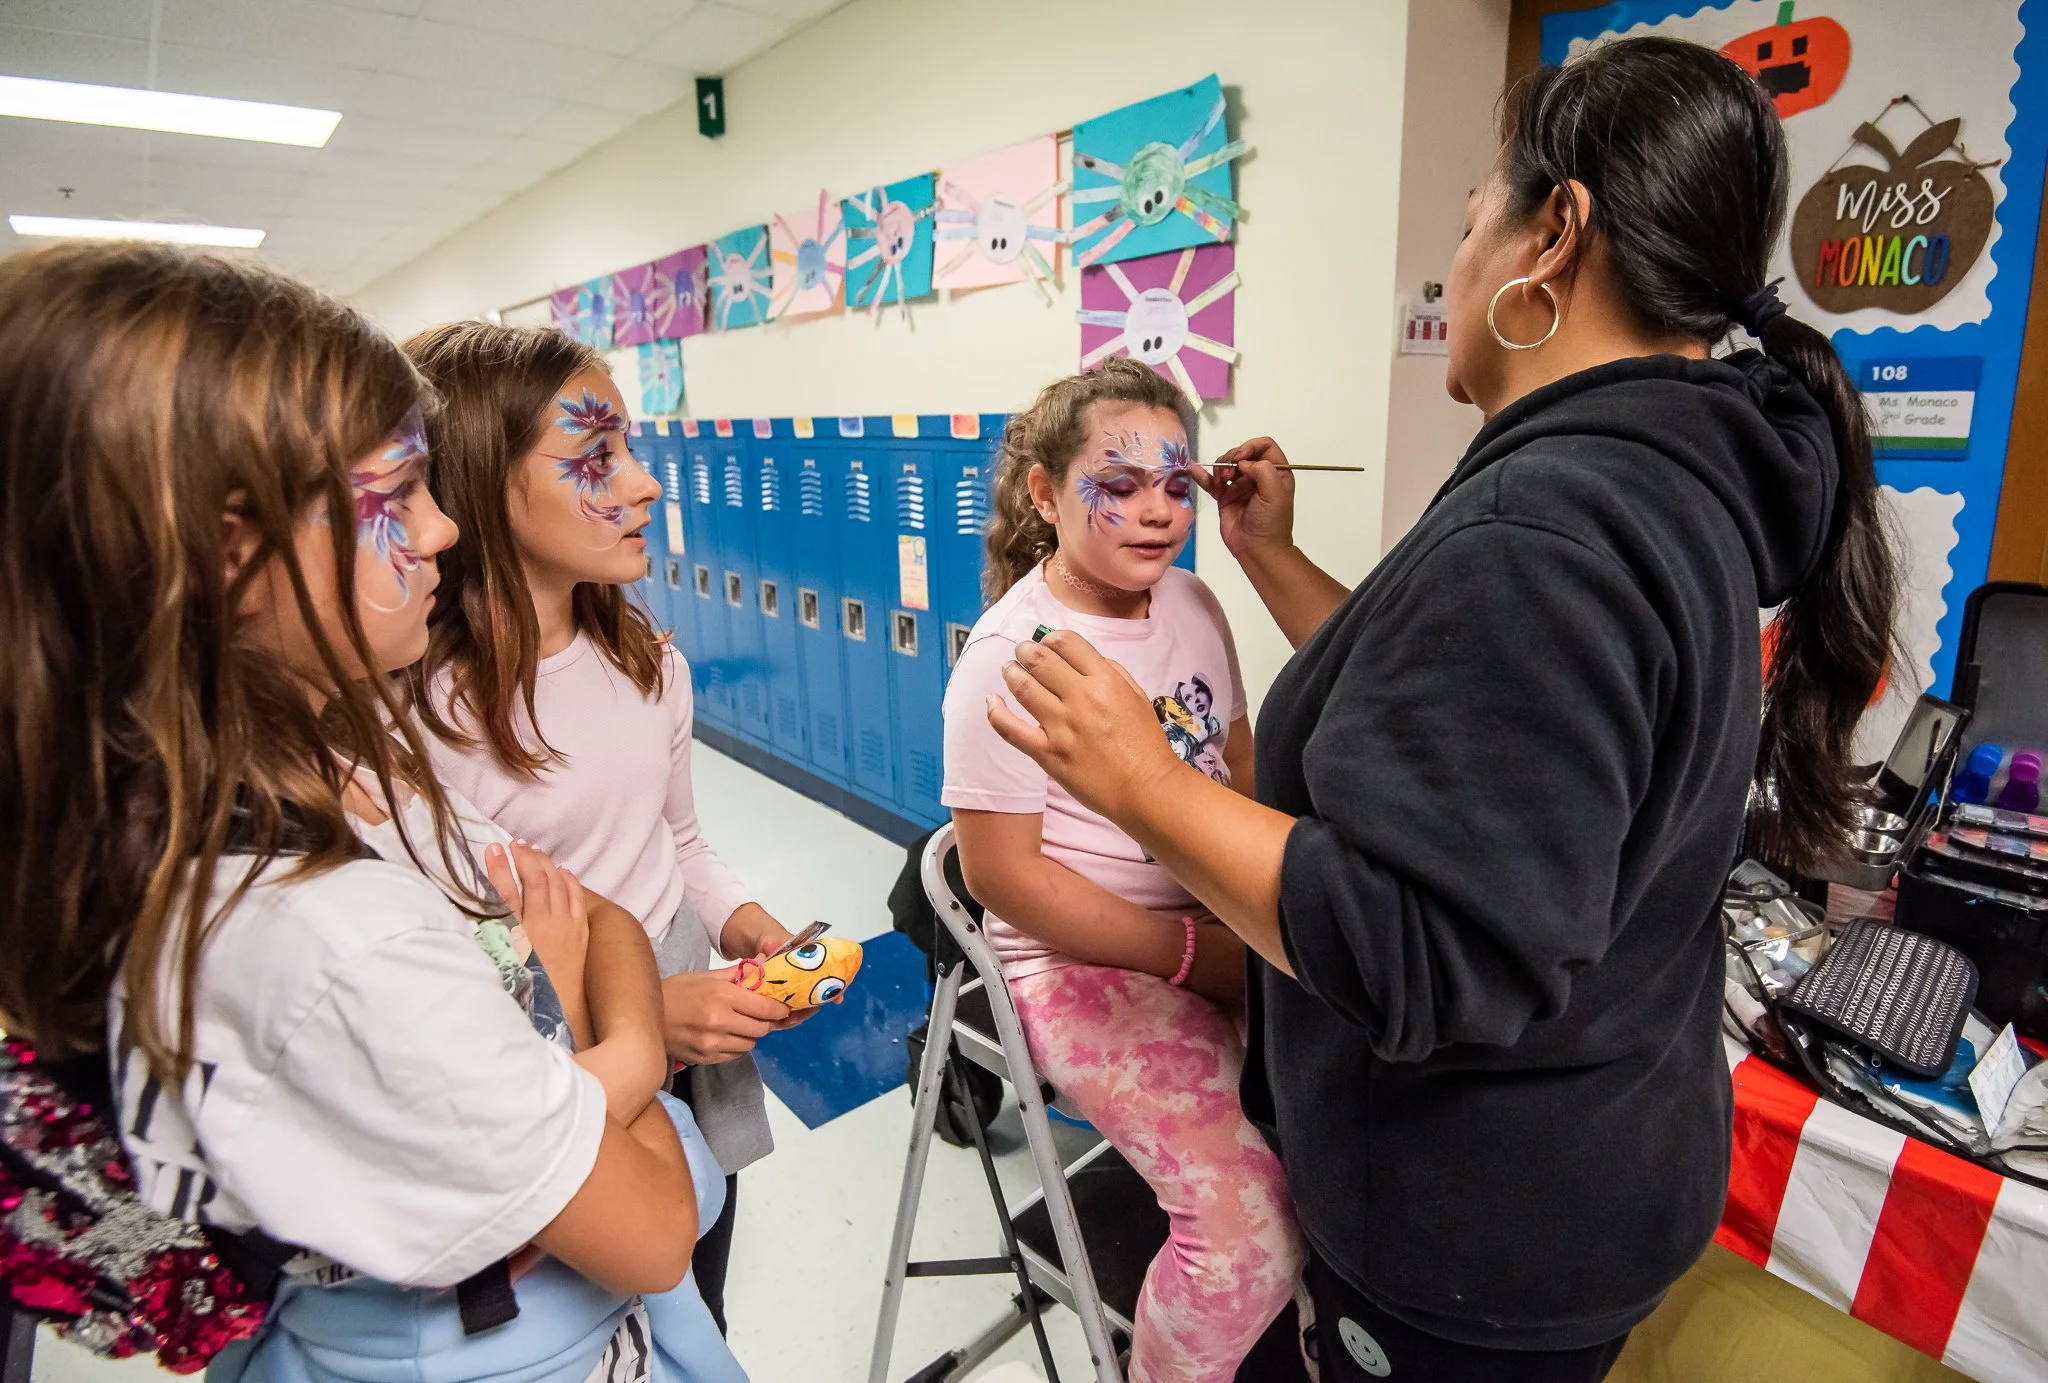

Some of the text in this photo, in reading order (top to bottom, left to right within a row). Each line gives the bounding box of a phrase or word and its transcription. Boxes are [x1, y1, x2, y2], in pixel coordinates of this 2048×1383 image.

[702, 92, 717, 121] 1
[1816, 234, 1949, 288] MONACO
[1872, 365, 1908, 381] 108
[1906, 396, 1959, 407] Monaco
[1904, 413, 1946, 426] Grade
